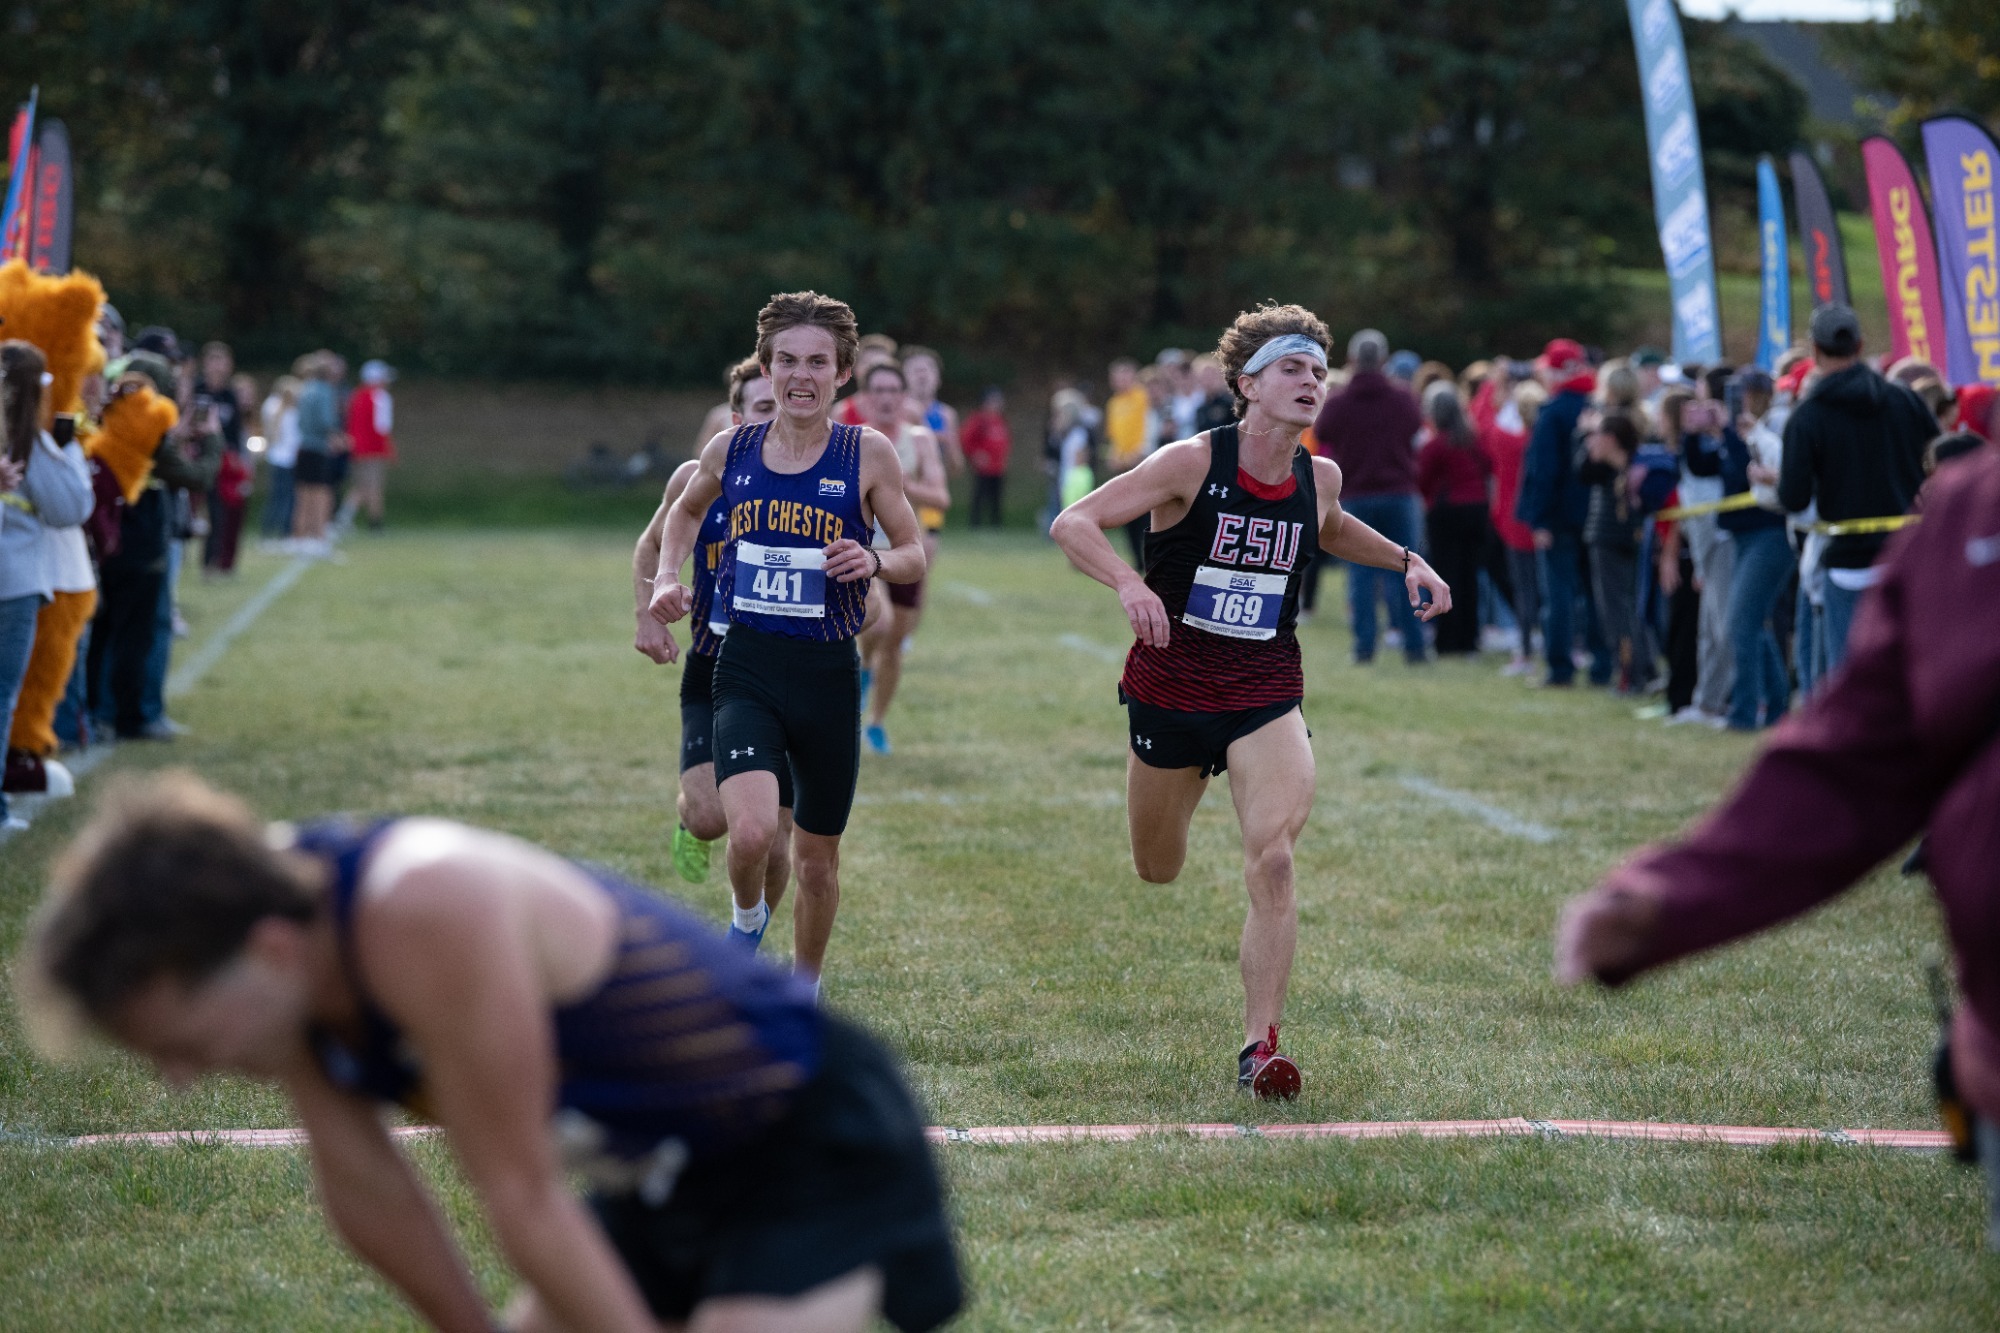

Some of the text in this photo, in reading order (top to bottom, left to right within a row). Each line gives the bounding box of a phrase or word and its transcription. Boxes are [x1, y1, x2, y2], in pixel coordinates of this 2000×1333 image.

[820, 482, 845, 492] PSAC
[731, 499, 844, 545] WEST CHESTER
[764, 553, 792, 563] PSAC
[1209, 512, 1304, 572] ESU
[752, 569, 802, 602] 441
[1230, 577, 1257, 587] PSAC
[1211, 592, 1263, 626] 169
